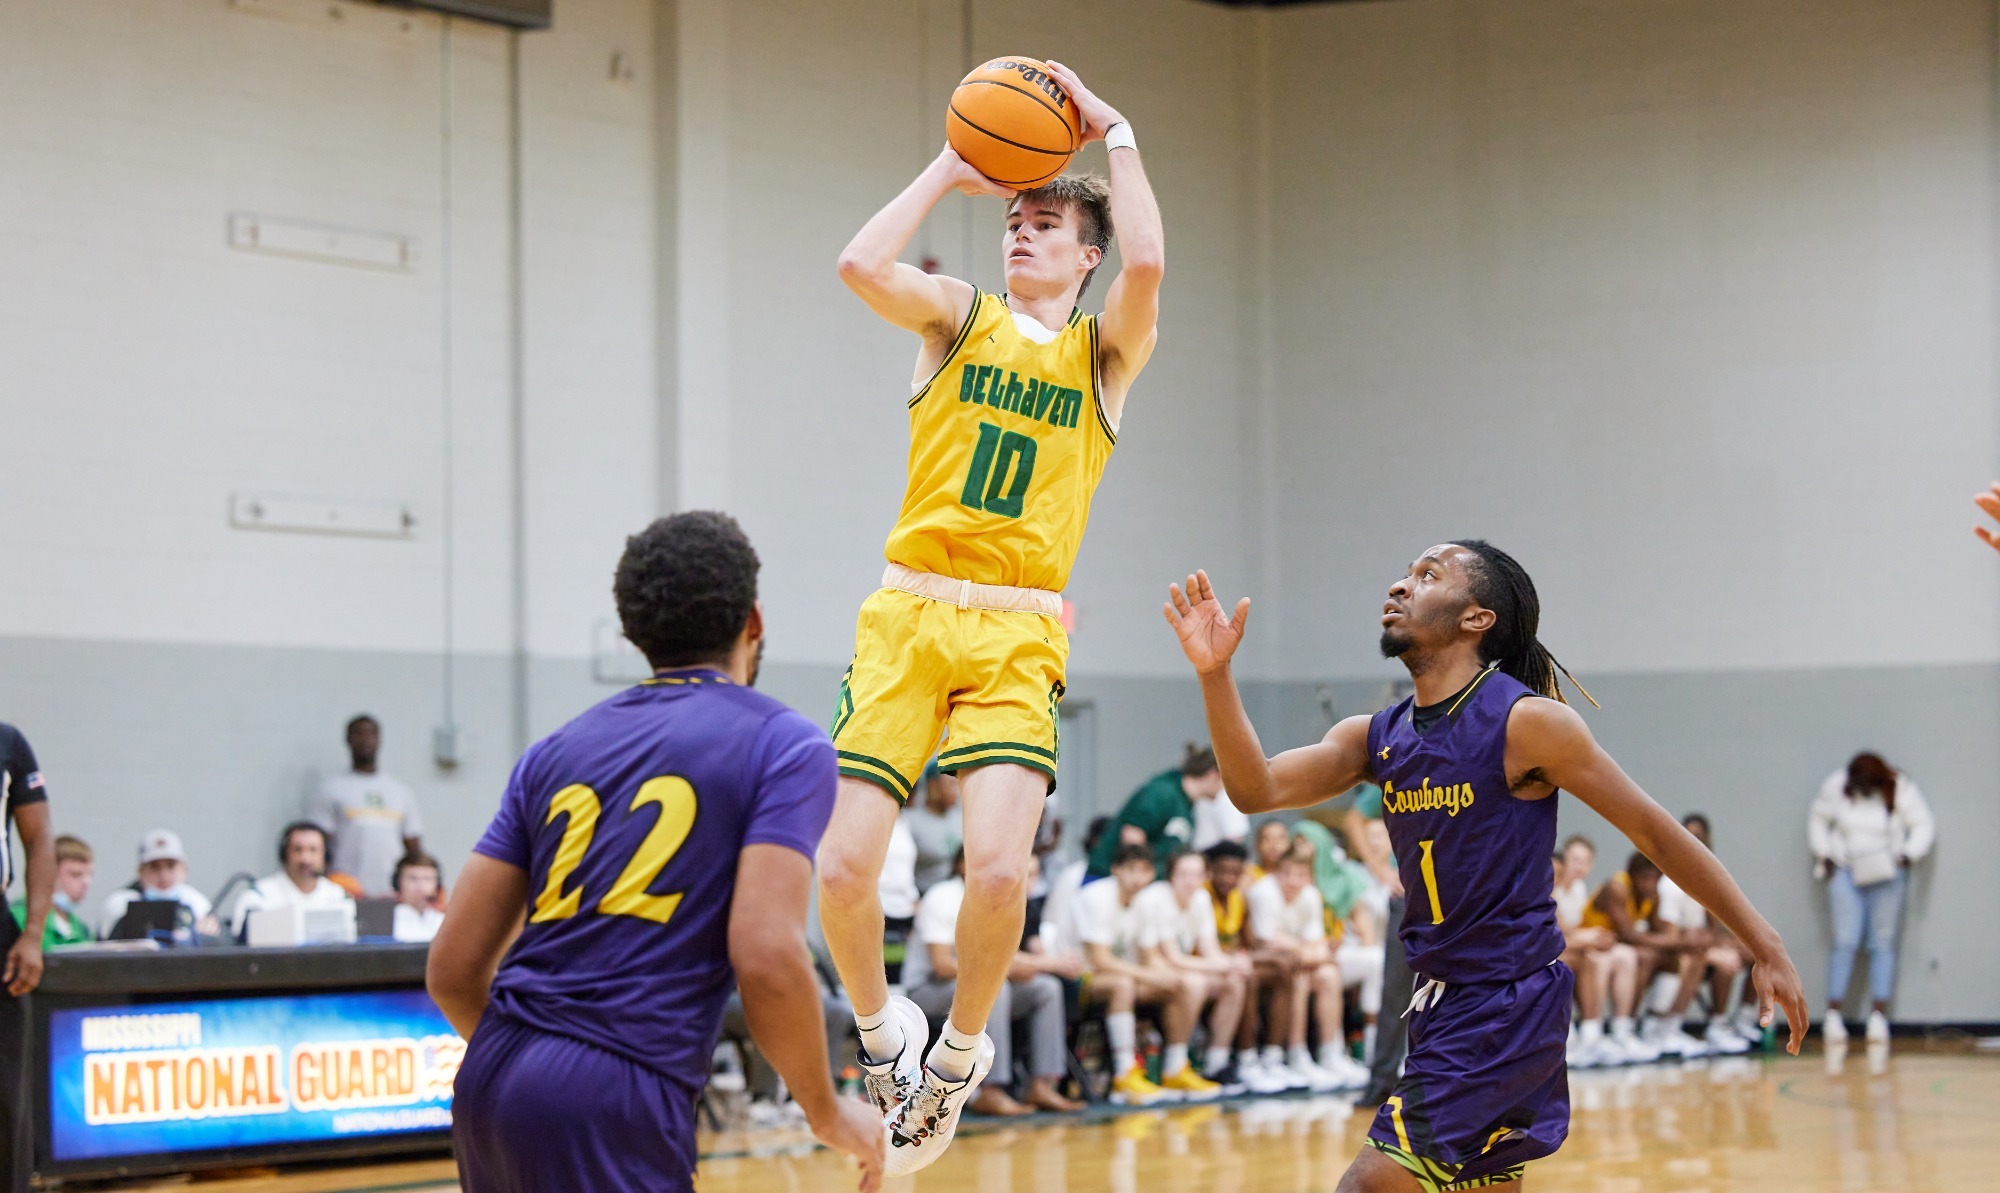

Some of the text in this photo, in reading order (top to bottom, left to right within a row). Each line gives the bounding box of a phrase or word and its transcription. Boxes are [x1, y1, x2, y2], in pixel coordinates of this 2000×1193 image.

[986, 61, 1067, 109] Wilson
[960, 421, 1038, 518] 10
[1383, 777, 1475, 817] Cowboys
[529, 775, 697, 924] 22
[1418, 840, 1445, 925] 1
[90, 1044, 417, 1120] NATIONAL GUARD
